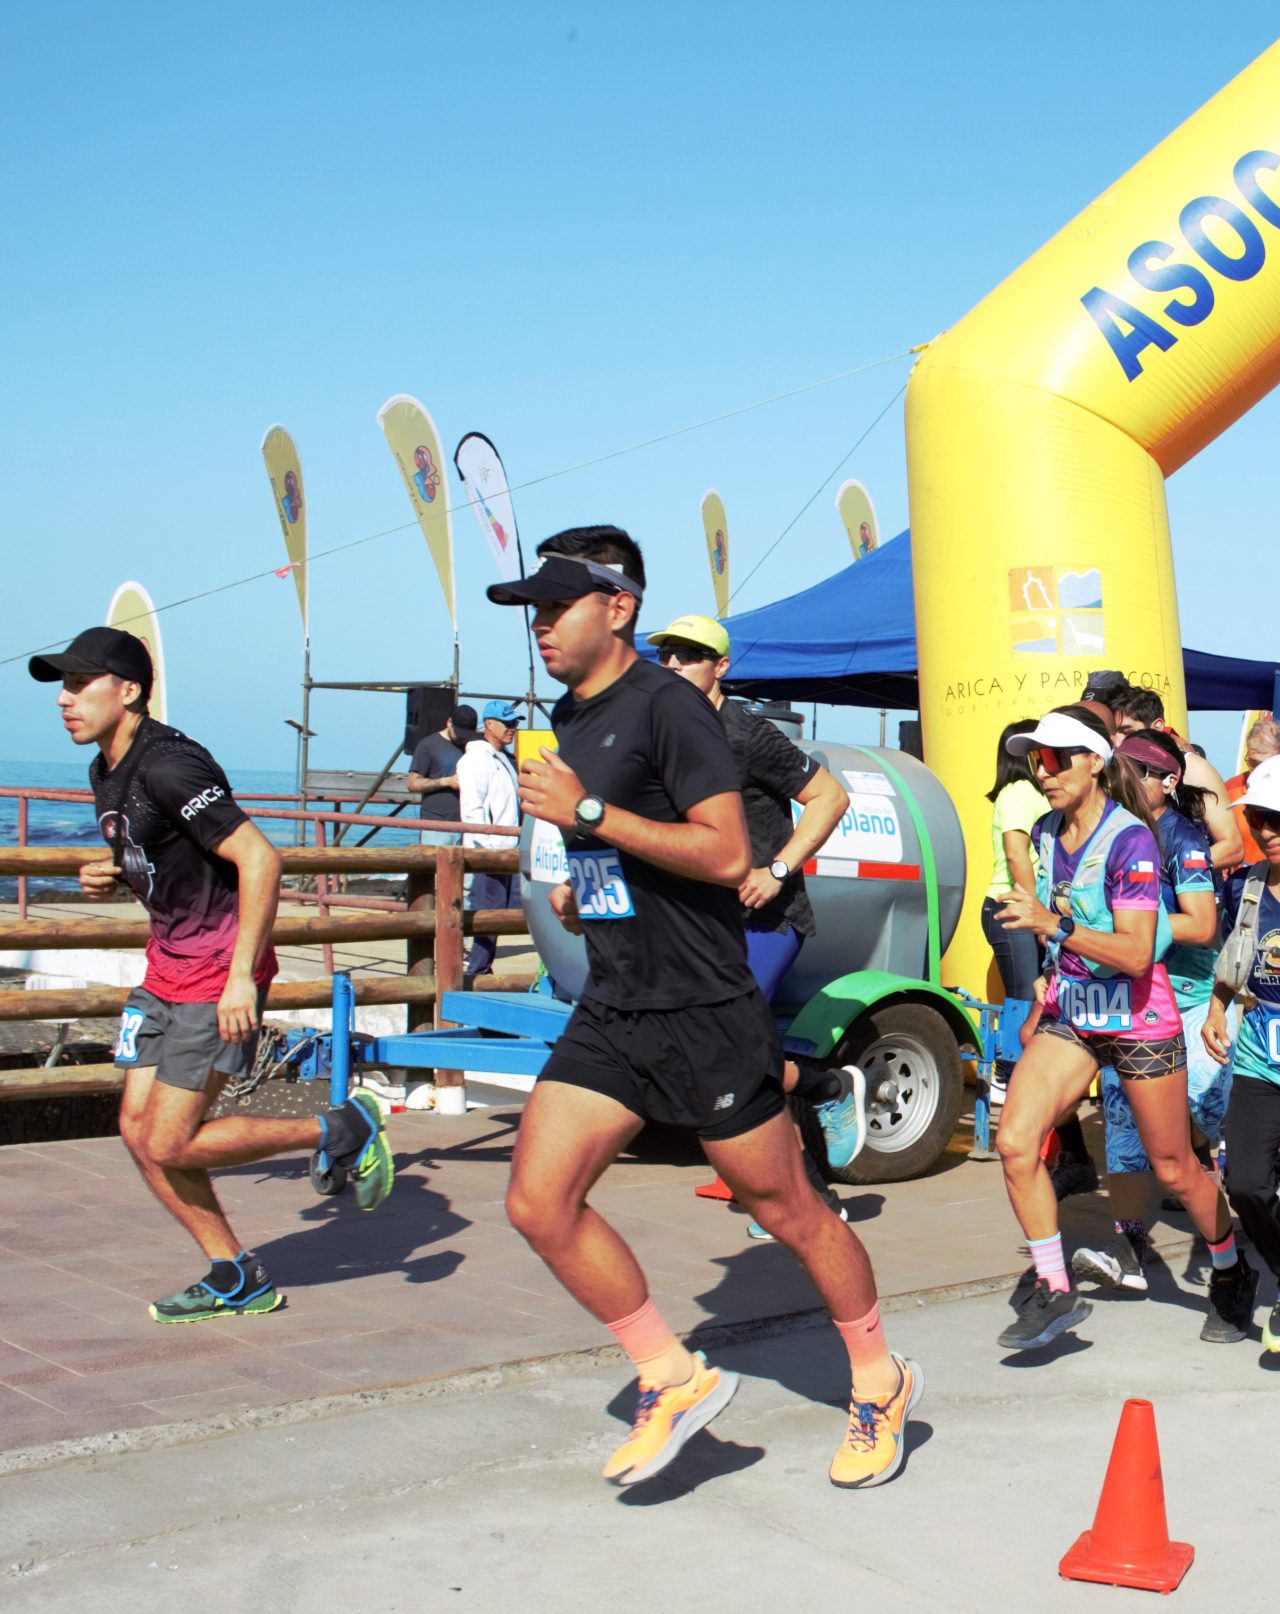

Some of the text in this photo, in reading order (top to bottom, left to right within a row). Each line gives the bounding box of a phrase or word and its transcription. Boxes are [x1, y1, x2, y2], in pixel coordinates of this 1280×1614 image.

[945, 670, 1172, 701] ARICA Y PARCOTA
[1058, 979, 1131, 1027] 0604
